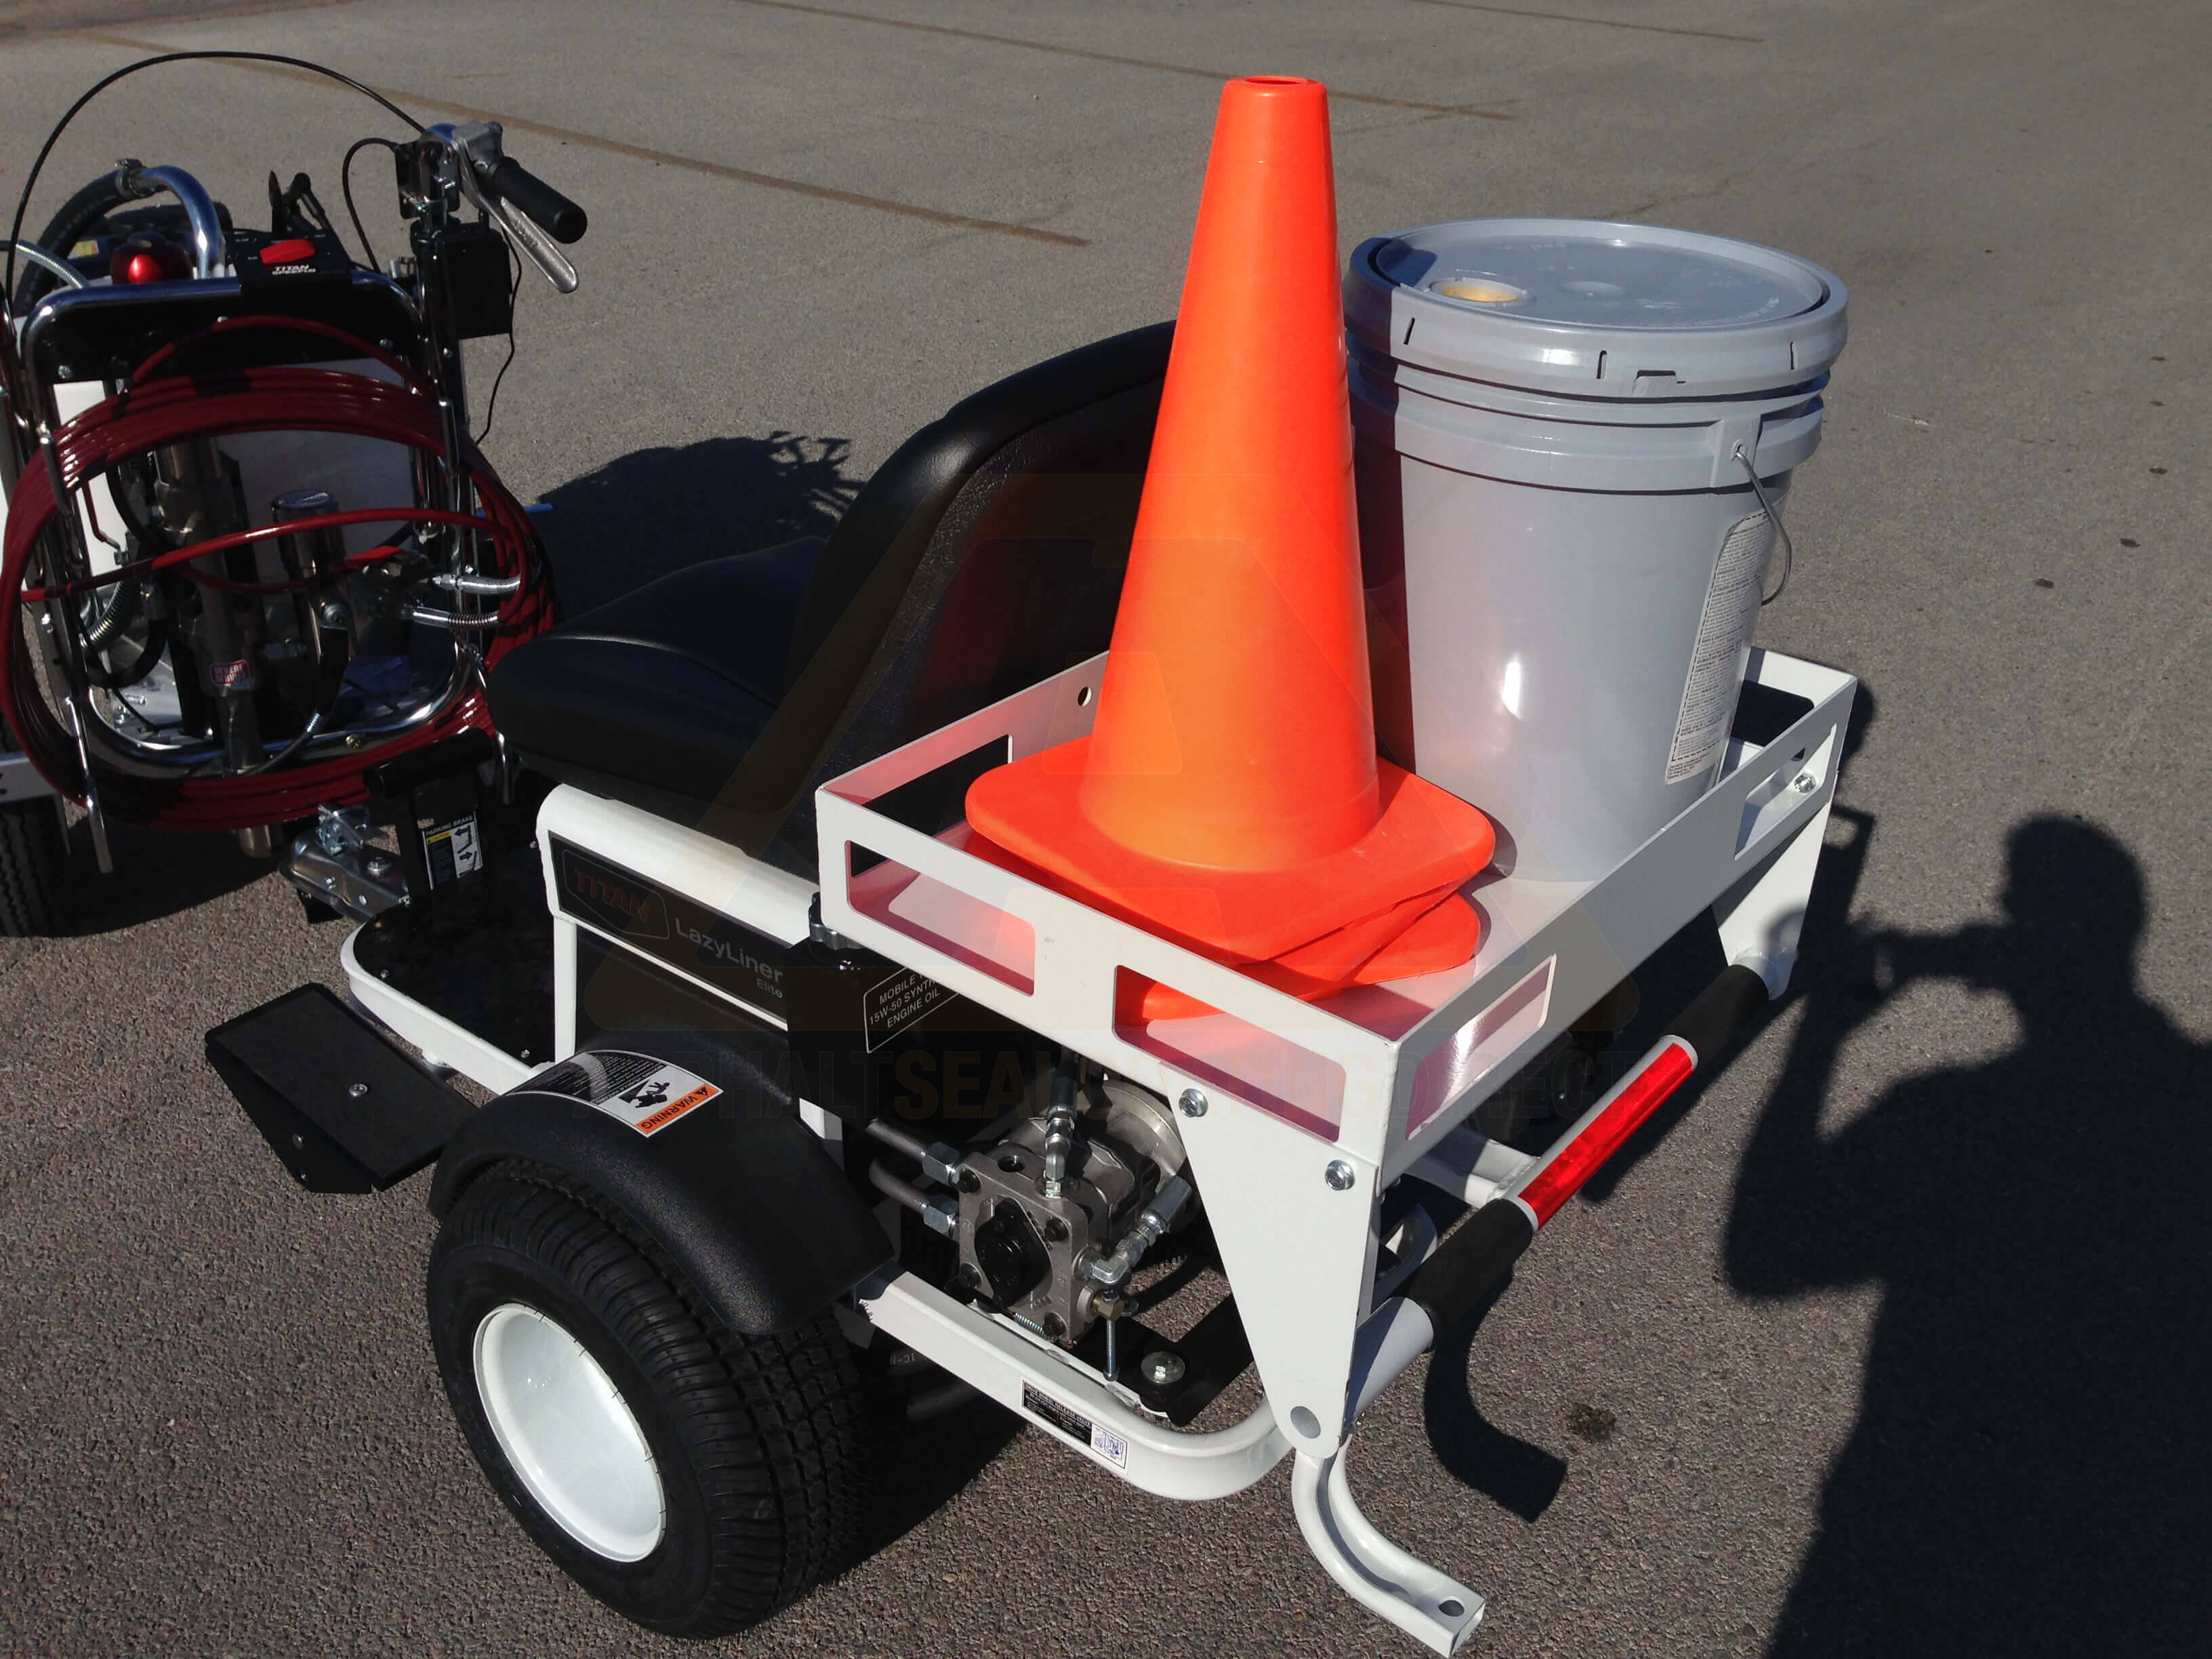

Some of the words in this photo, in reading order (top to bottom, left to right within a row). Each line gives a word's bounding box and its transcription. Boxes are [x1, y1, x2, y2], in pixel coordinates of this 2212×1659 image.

[574, 863, 651, 924] TITAN
[674, 916, 784, 983] LazyLiner
[756, 977, 783, 999] Elite
[879, 974, 916, 1006] MOBILE
[869, 997, 903, 1025] 15W-50
[886, 998, 923, 1029] ENGINE
[924, 988, 941, 1003] OIL
[640, 1095, 698, 1130] WARNING
